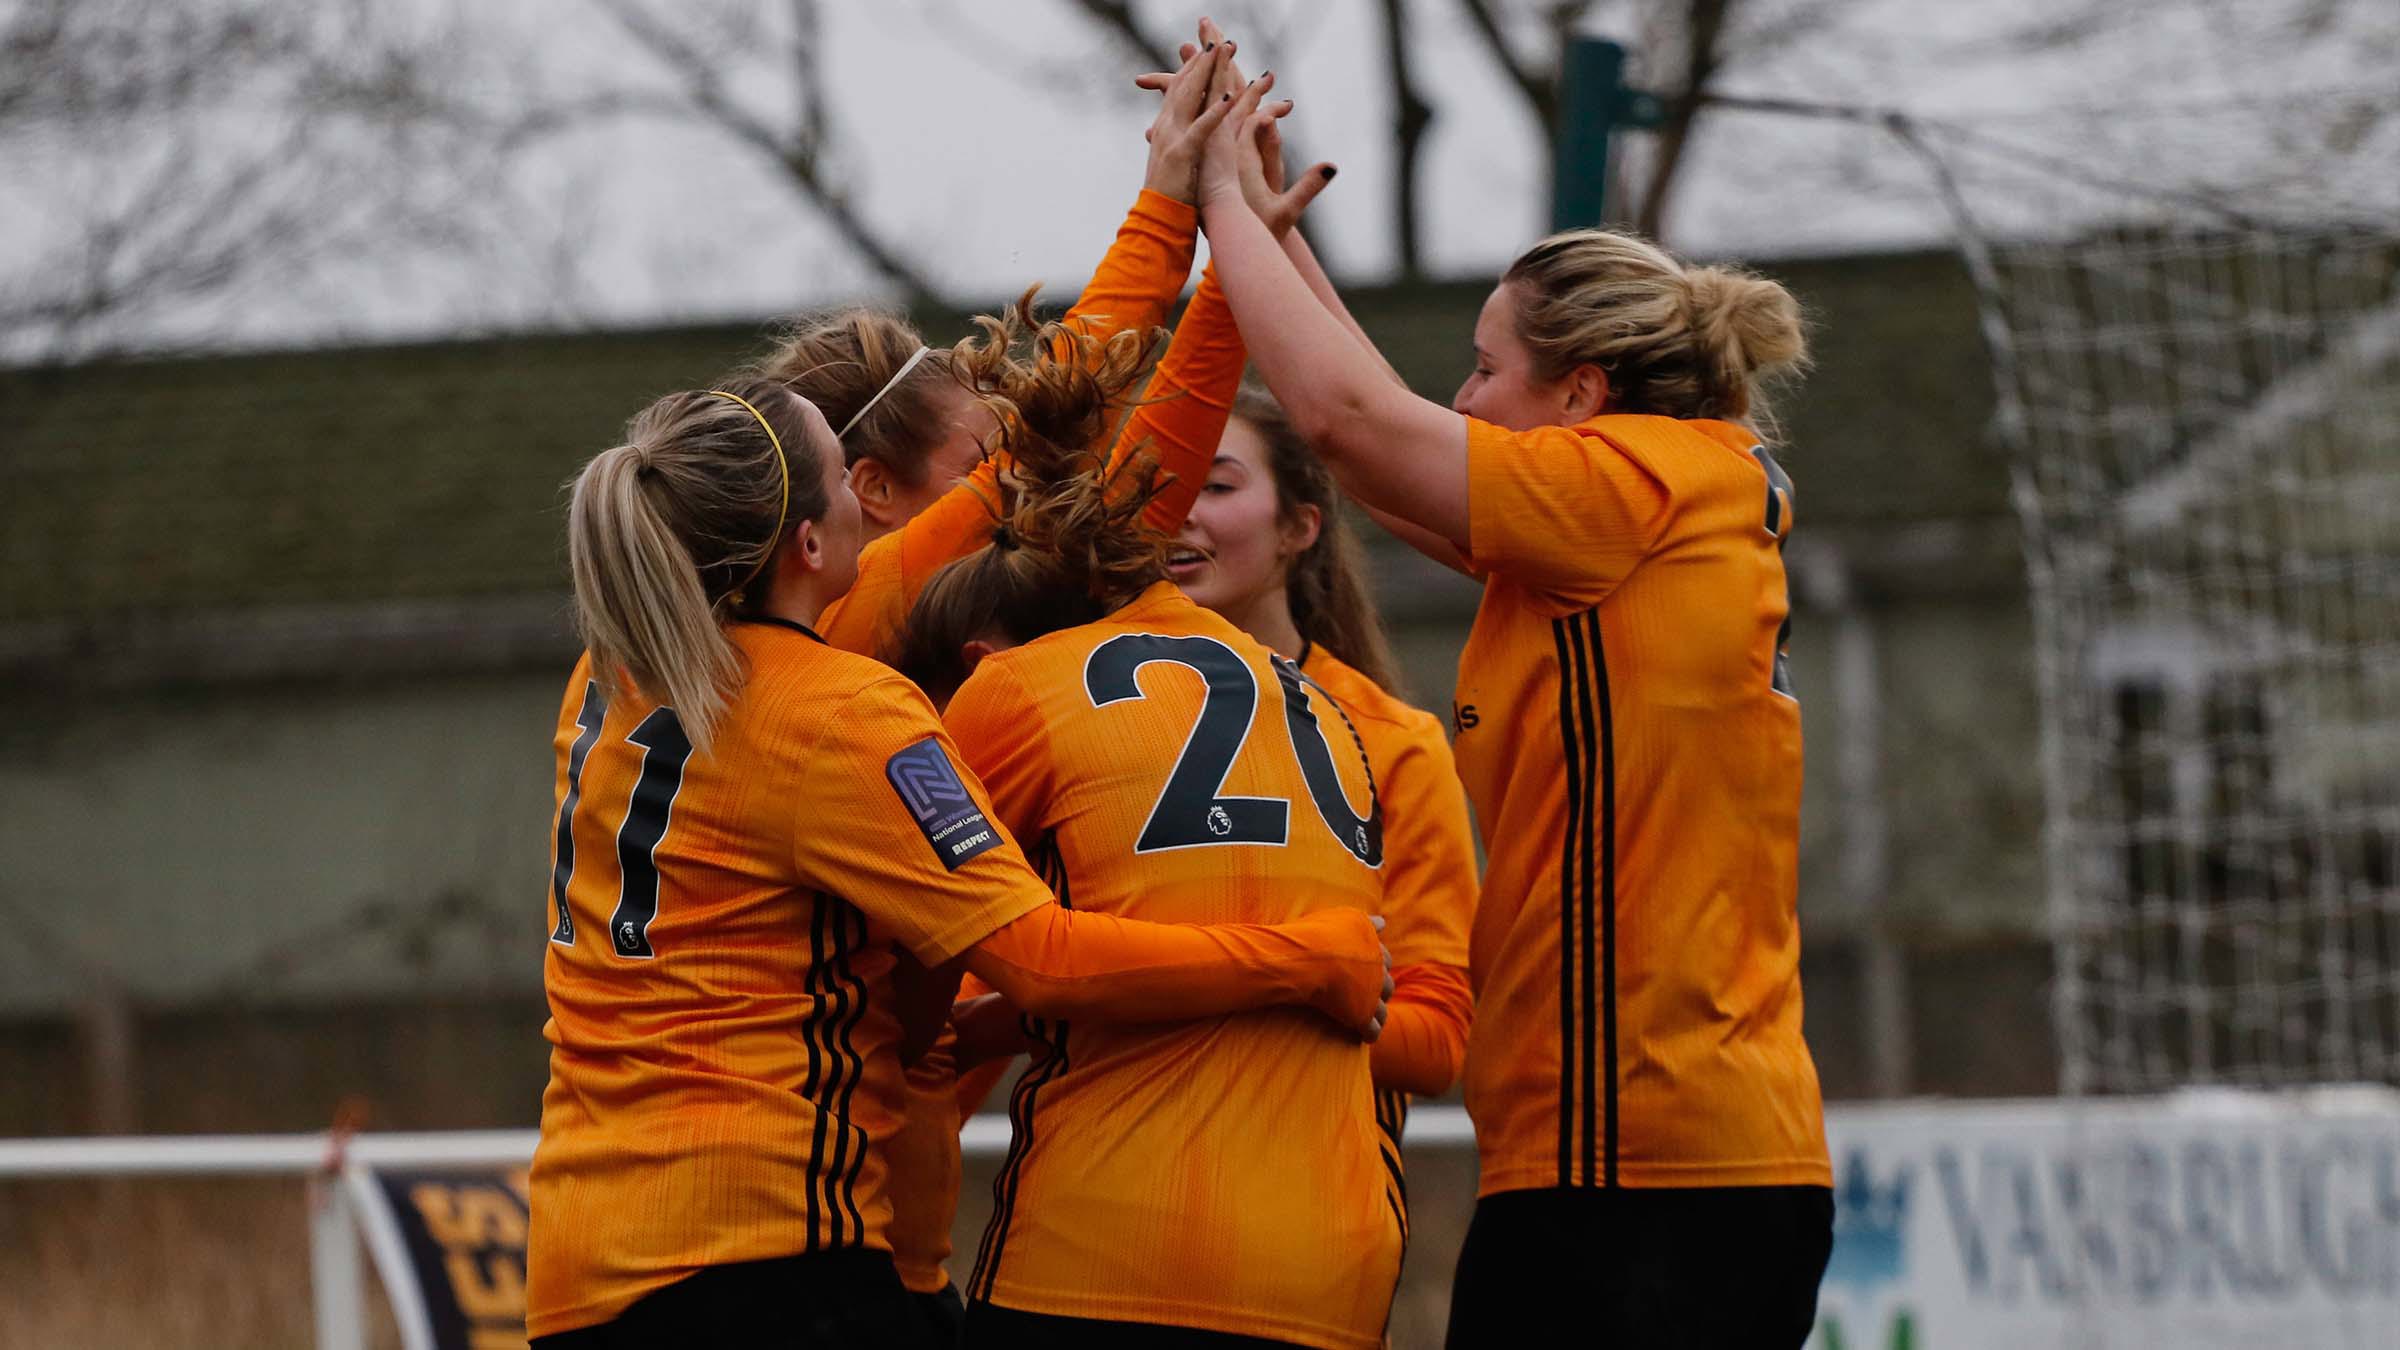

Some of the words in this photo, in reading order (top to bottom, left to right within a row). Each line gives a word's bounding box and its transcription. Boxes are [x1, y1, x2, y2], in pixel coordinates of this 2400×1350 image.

[1084, 632, 1384, 869] 20
[551, 679, 694, 959] 11
[932, 819, 964, 842] National
[962, 813, 984, 825] Leagu
[951, 830, 990, 856] RESPECT
